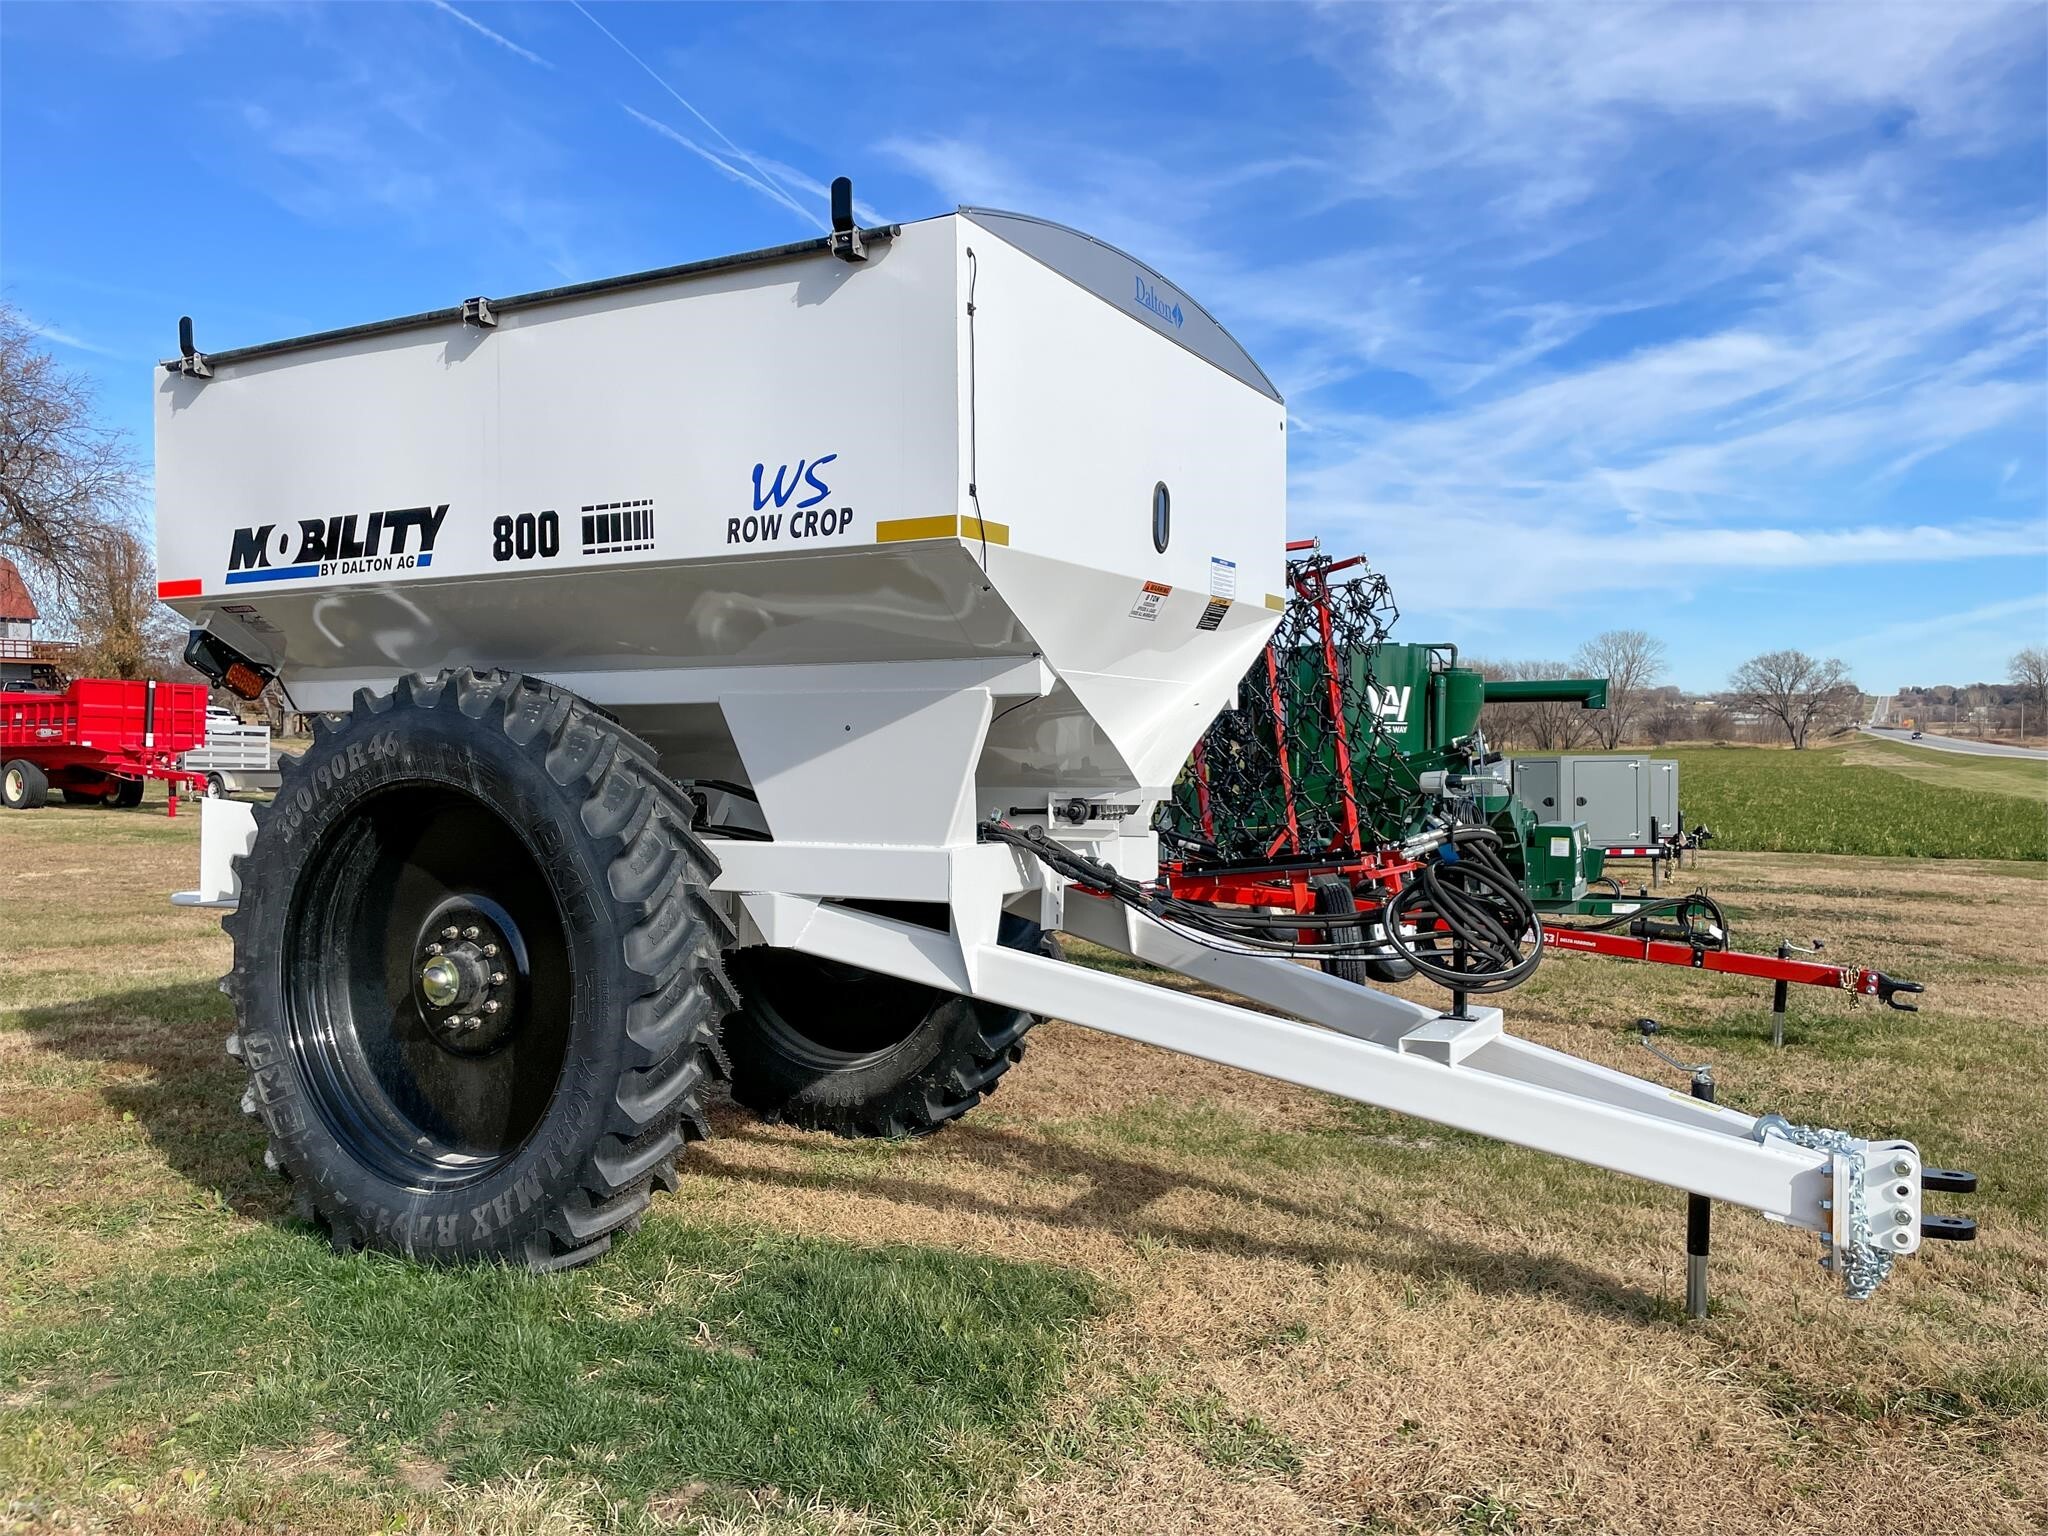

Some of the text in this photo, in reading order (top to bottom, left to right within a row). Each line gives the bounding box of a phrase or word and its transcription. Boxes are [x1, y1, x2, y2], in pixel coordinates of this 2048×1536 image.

[1135, 275, 1172, 321] Dalton
[752, 453, 838, 511] WS
[228, 503, 450, 571] MOBILITY
[493, 510, 560, 562] 800
[727, 507, 853, 544] ROW CROP
[320, 555, 415, 577] BY DALTON AG
